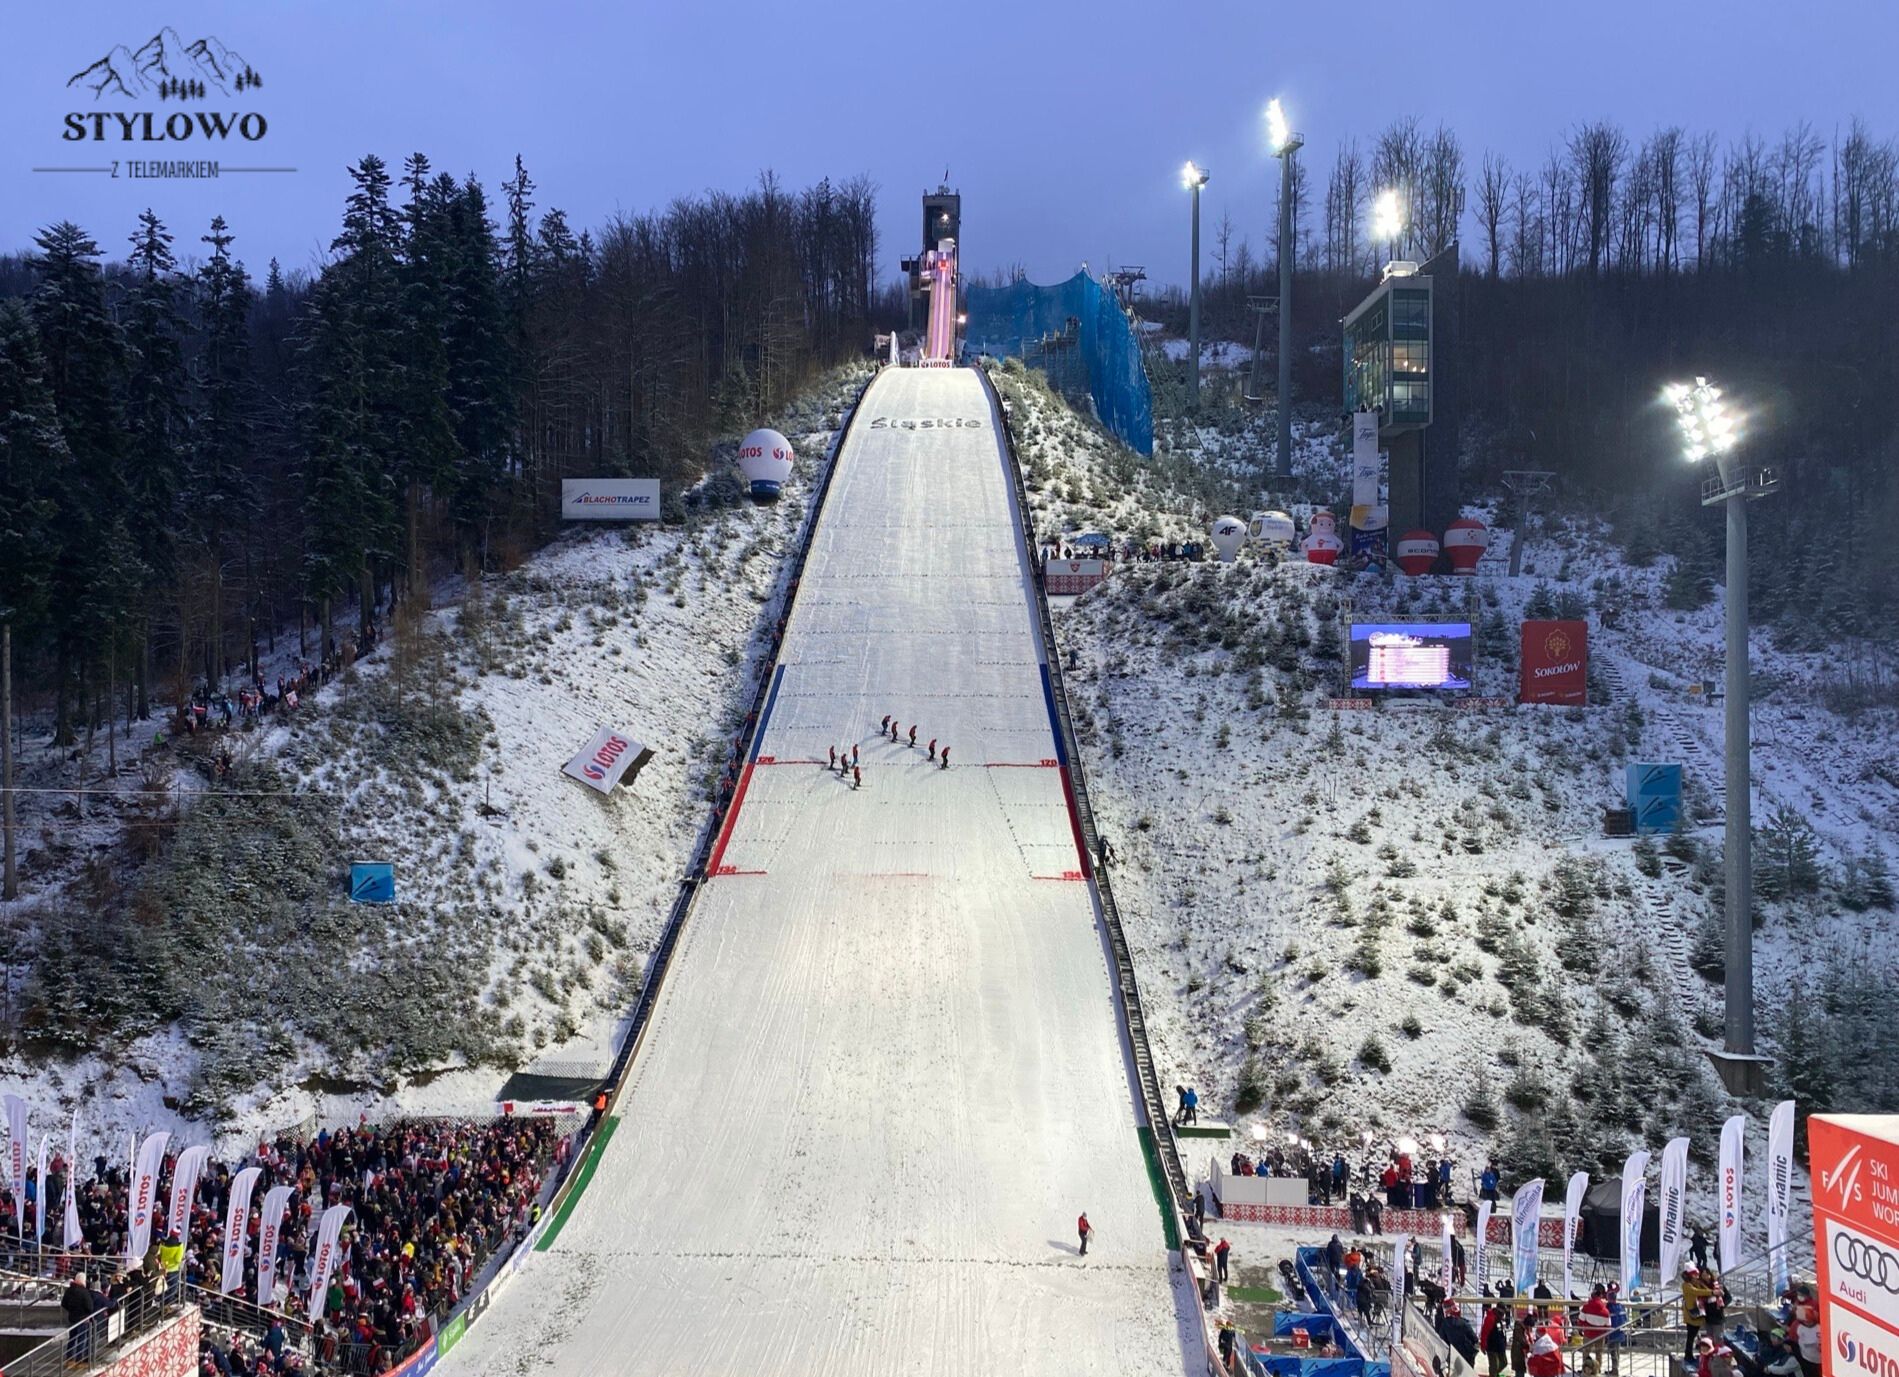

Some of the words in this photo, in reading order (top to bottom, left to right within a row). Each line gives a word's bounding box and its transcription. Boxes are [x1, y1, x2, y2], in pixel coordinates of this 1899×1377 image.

[929, 361, 951, 369] LOTOS
[583, 496, 651, 504] BLACHOTRAPEZ
[592, 736, 628, 769] LOTOS
[1040, 759, 1058, 767] 120
[1870, 1159, 1888, 1180] SKI
[137, 1175, 152, 1211] LOTOS
[1726, 1168, 1735, 1209] LOTOS
[175, 1188, 188, 1223] LOTOS
[231, 1207, 244, 1244] LOTOS
[263, 1224, 275, 1258] LOTOS
[317, 1243, 331, 1276] LOTOS
[1840, 1281, 1867, 1304] Audi
